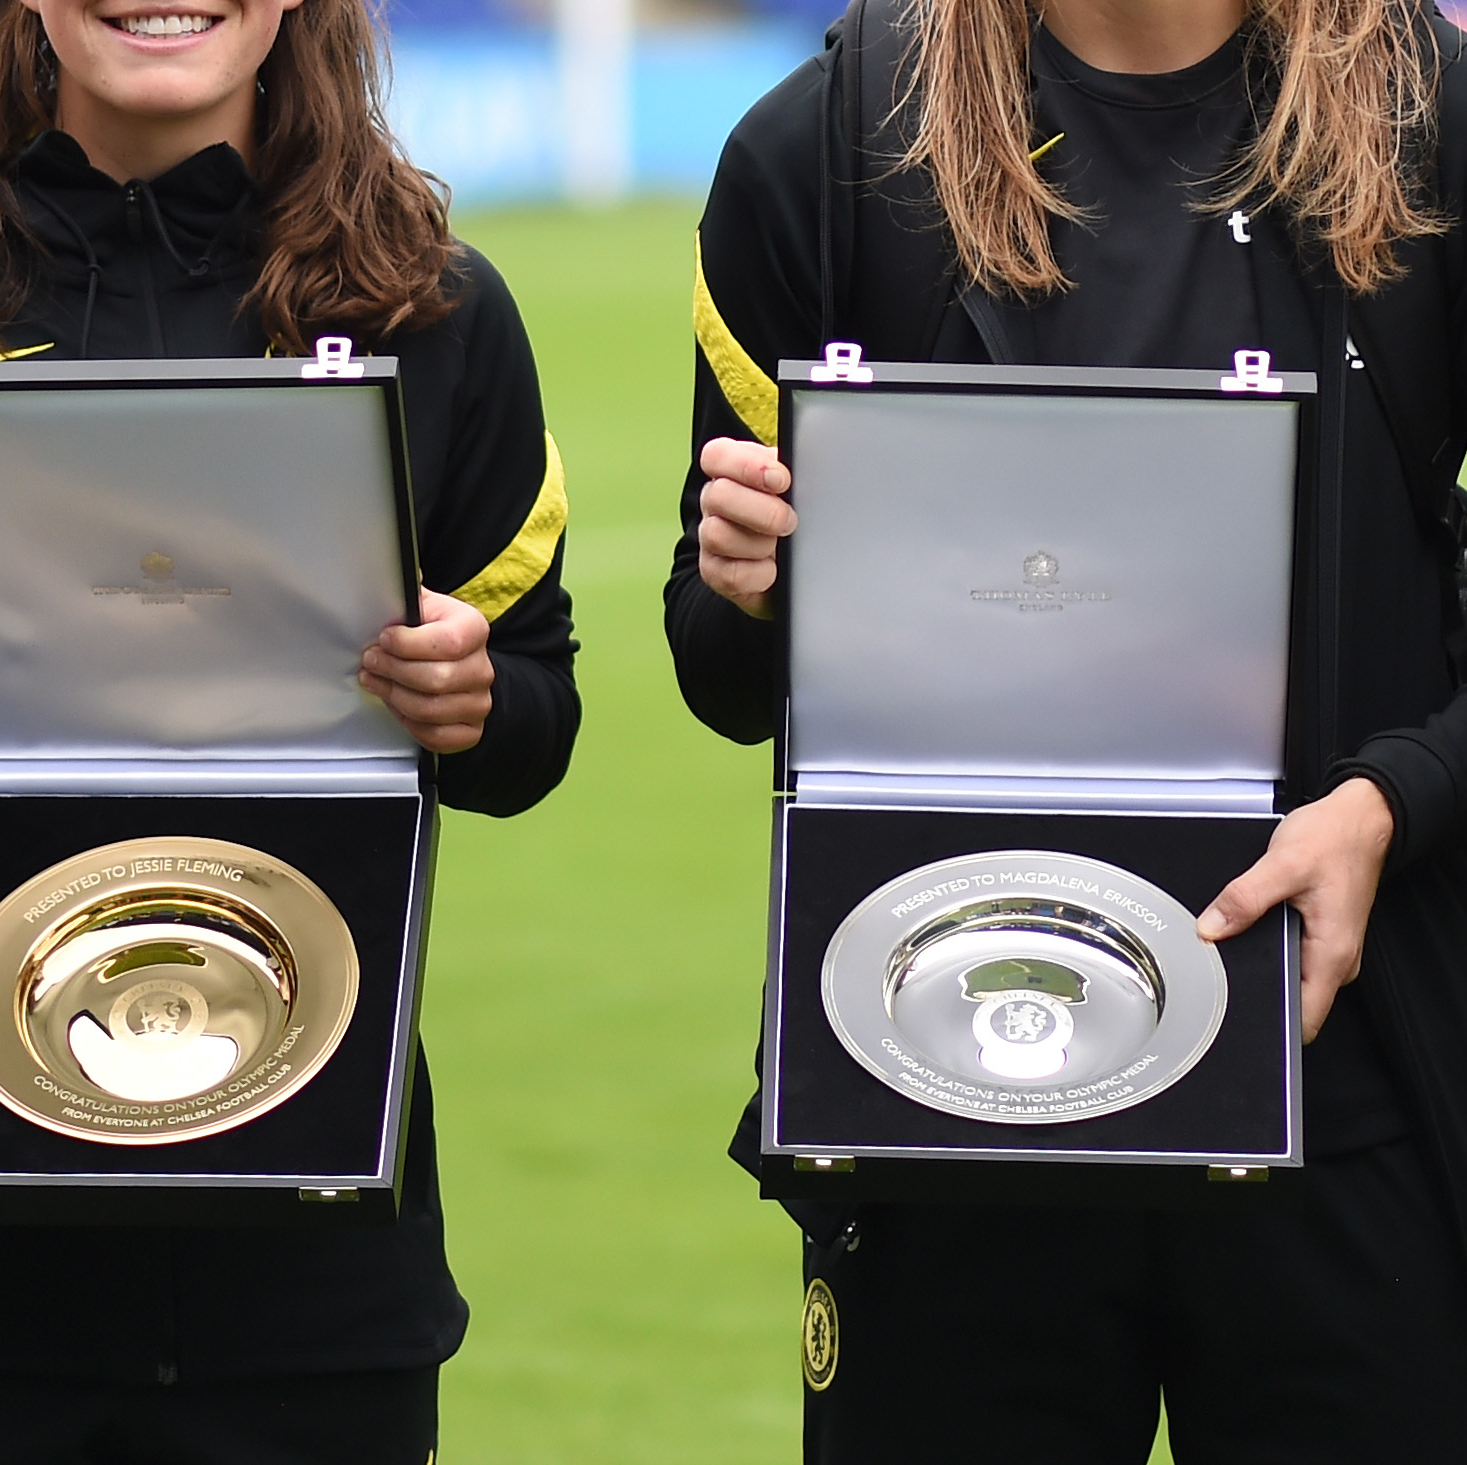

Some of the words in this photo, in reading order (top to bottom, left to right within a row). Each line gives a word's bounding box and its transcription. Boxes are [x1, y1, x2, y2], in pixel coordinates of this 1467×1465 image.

[23, 873, 101, 924] PRESENTED
[101, 865, 126, 881] TO
[130, 859, 173, 878] JESSIE
[176, 859, 244, 883] FLEMING
[891, 878, 970, 919] PRESENTED
[970, 875, 996, 888] TO
[1000, 871, 1100, 896] MAGDALENA
[1102, 889, 1169, 933] ERIKSSON
[33, 1075, 160, 1116] CONGRATULATIONS
[163, 1102, 187, 1113] ON
[187, 1089, 227, 1109] YOUR
[228, 1056, 279, 1093] OLYMPIC
[273, 1024, 306, 1059] MEDAL
[61, 1107, 92, 1122] FROM
[93, 1115, 149, 1128] EVERYONE
[149, 1118, 165, 1127] AT
[167, 1106, 216, 1125] CHELSEA
[216, 1082, 270, 1113] FOOTBALL
[267, 1063, 292, 1084] CLUB
[881, 1038, 995, 1100] CONGRATULATIONS
[998, 1091, 1023, 1103] ON
[1022, 1091, 1064, 1103] YOUR
[1066, 1075, 1123, 1099] OLYMPIC
[1121, 1054, 1160, 1080] MEDAL
[898, 1071, 928, 1090] FROM
[926, 1086, 981, 1109] EVERYONE
[981, 1101, 997, 1111] AT
[998, 1104, 1050, 1114] CHELSEA
[1050, 1096, 1107, 1112] FOOTBALL
[1107, 1086, 1134, 1100] CLUB
